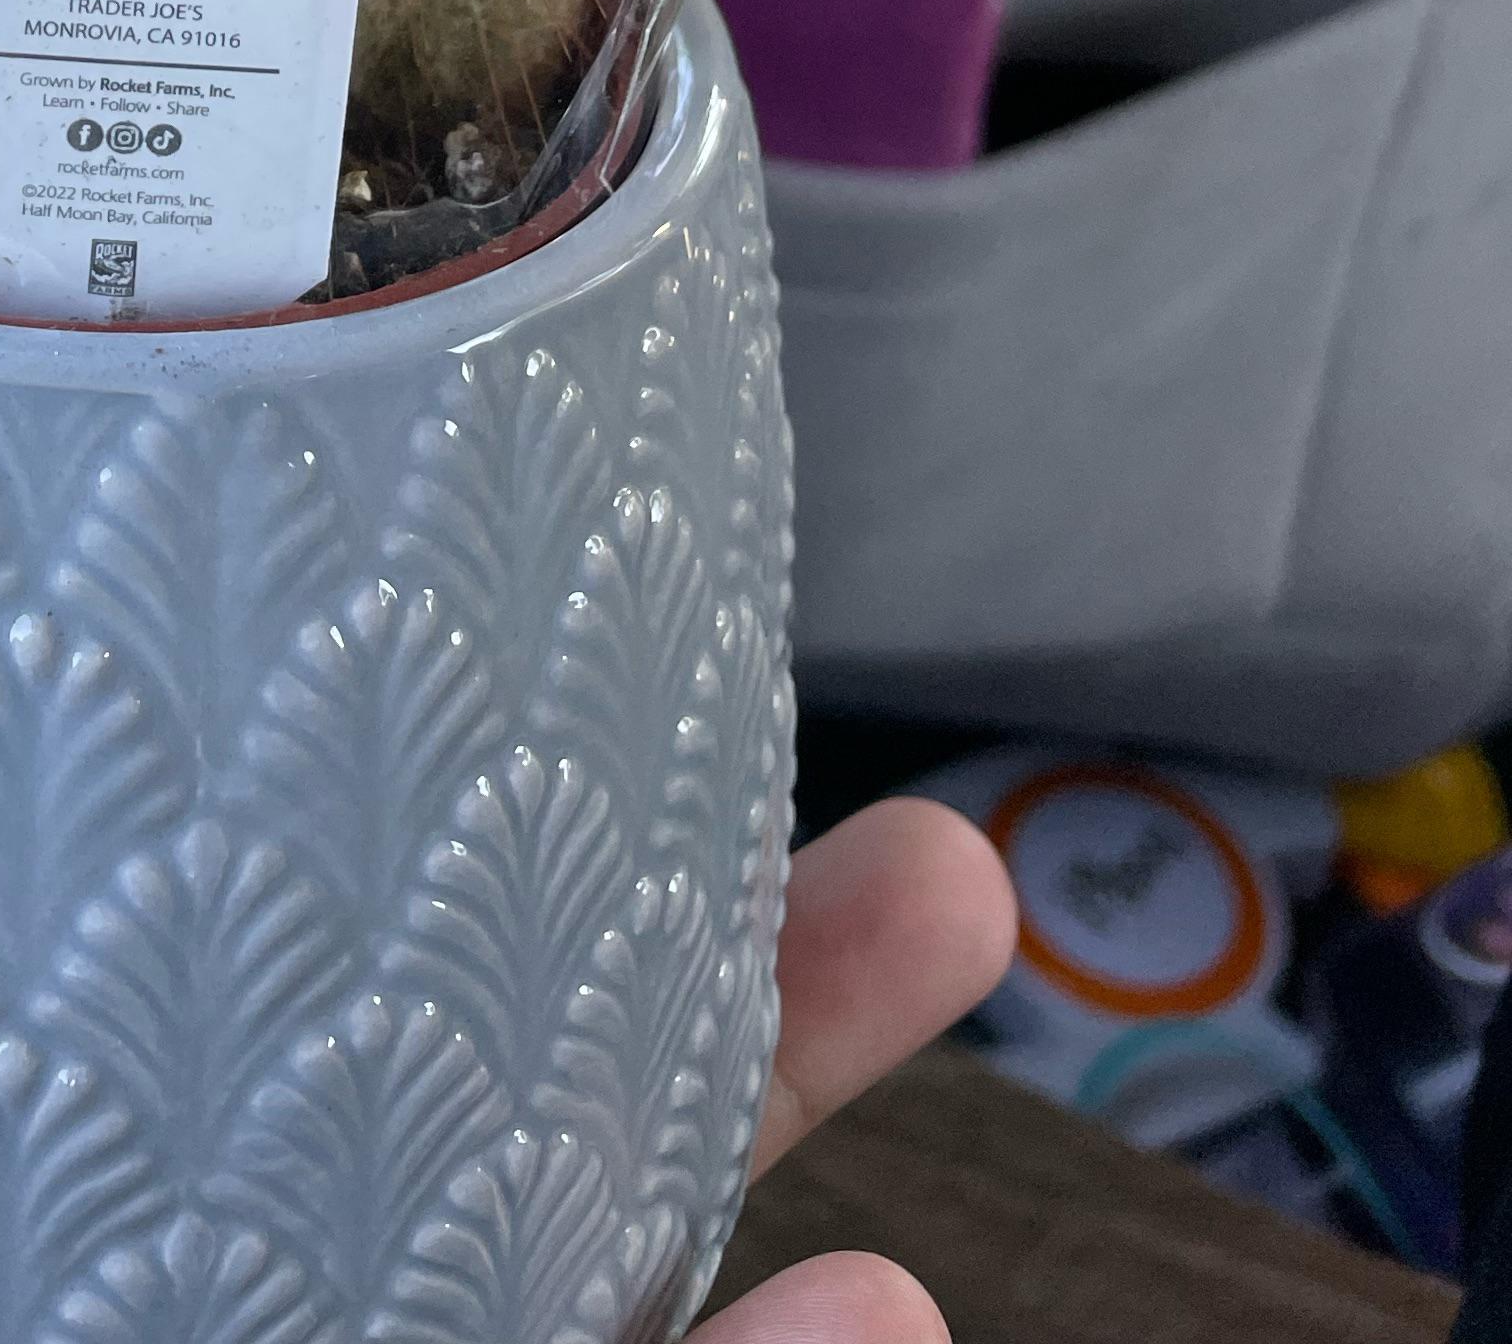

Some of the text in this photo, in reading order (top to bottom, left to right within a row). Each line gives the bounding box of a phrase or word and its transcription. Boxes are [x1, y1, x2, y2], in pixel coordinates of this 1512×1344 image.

[149, 2, 203, 21] JOE'S
[24, 19, 241, 48] MONROVIA, CA 91016
[20, 72, 236, 100] Grown by Rocket Farms, Inc.
[42, 94, 210, 117] Learn Follow Share
[57, 159, 185, 181] rocketfarms.com
[21, 183, 214, 208] ©2022 Rocket Farms, Inc.
[21, 203, 213, 226] Half Moon Bay, California
